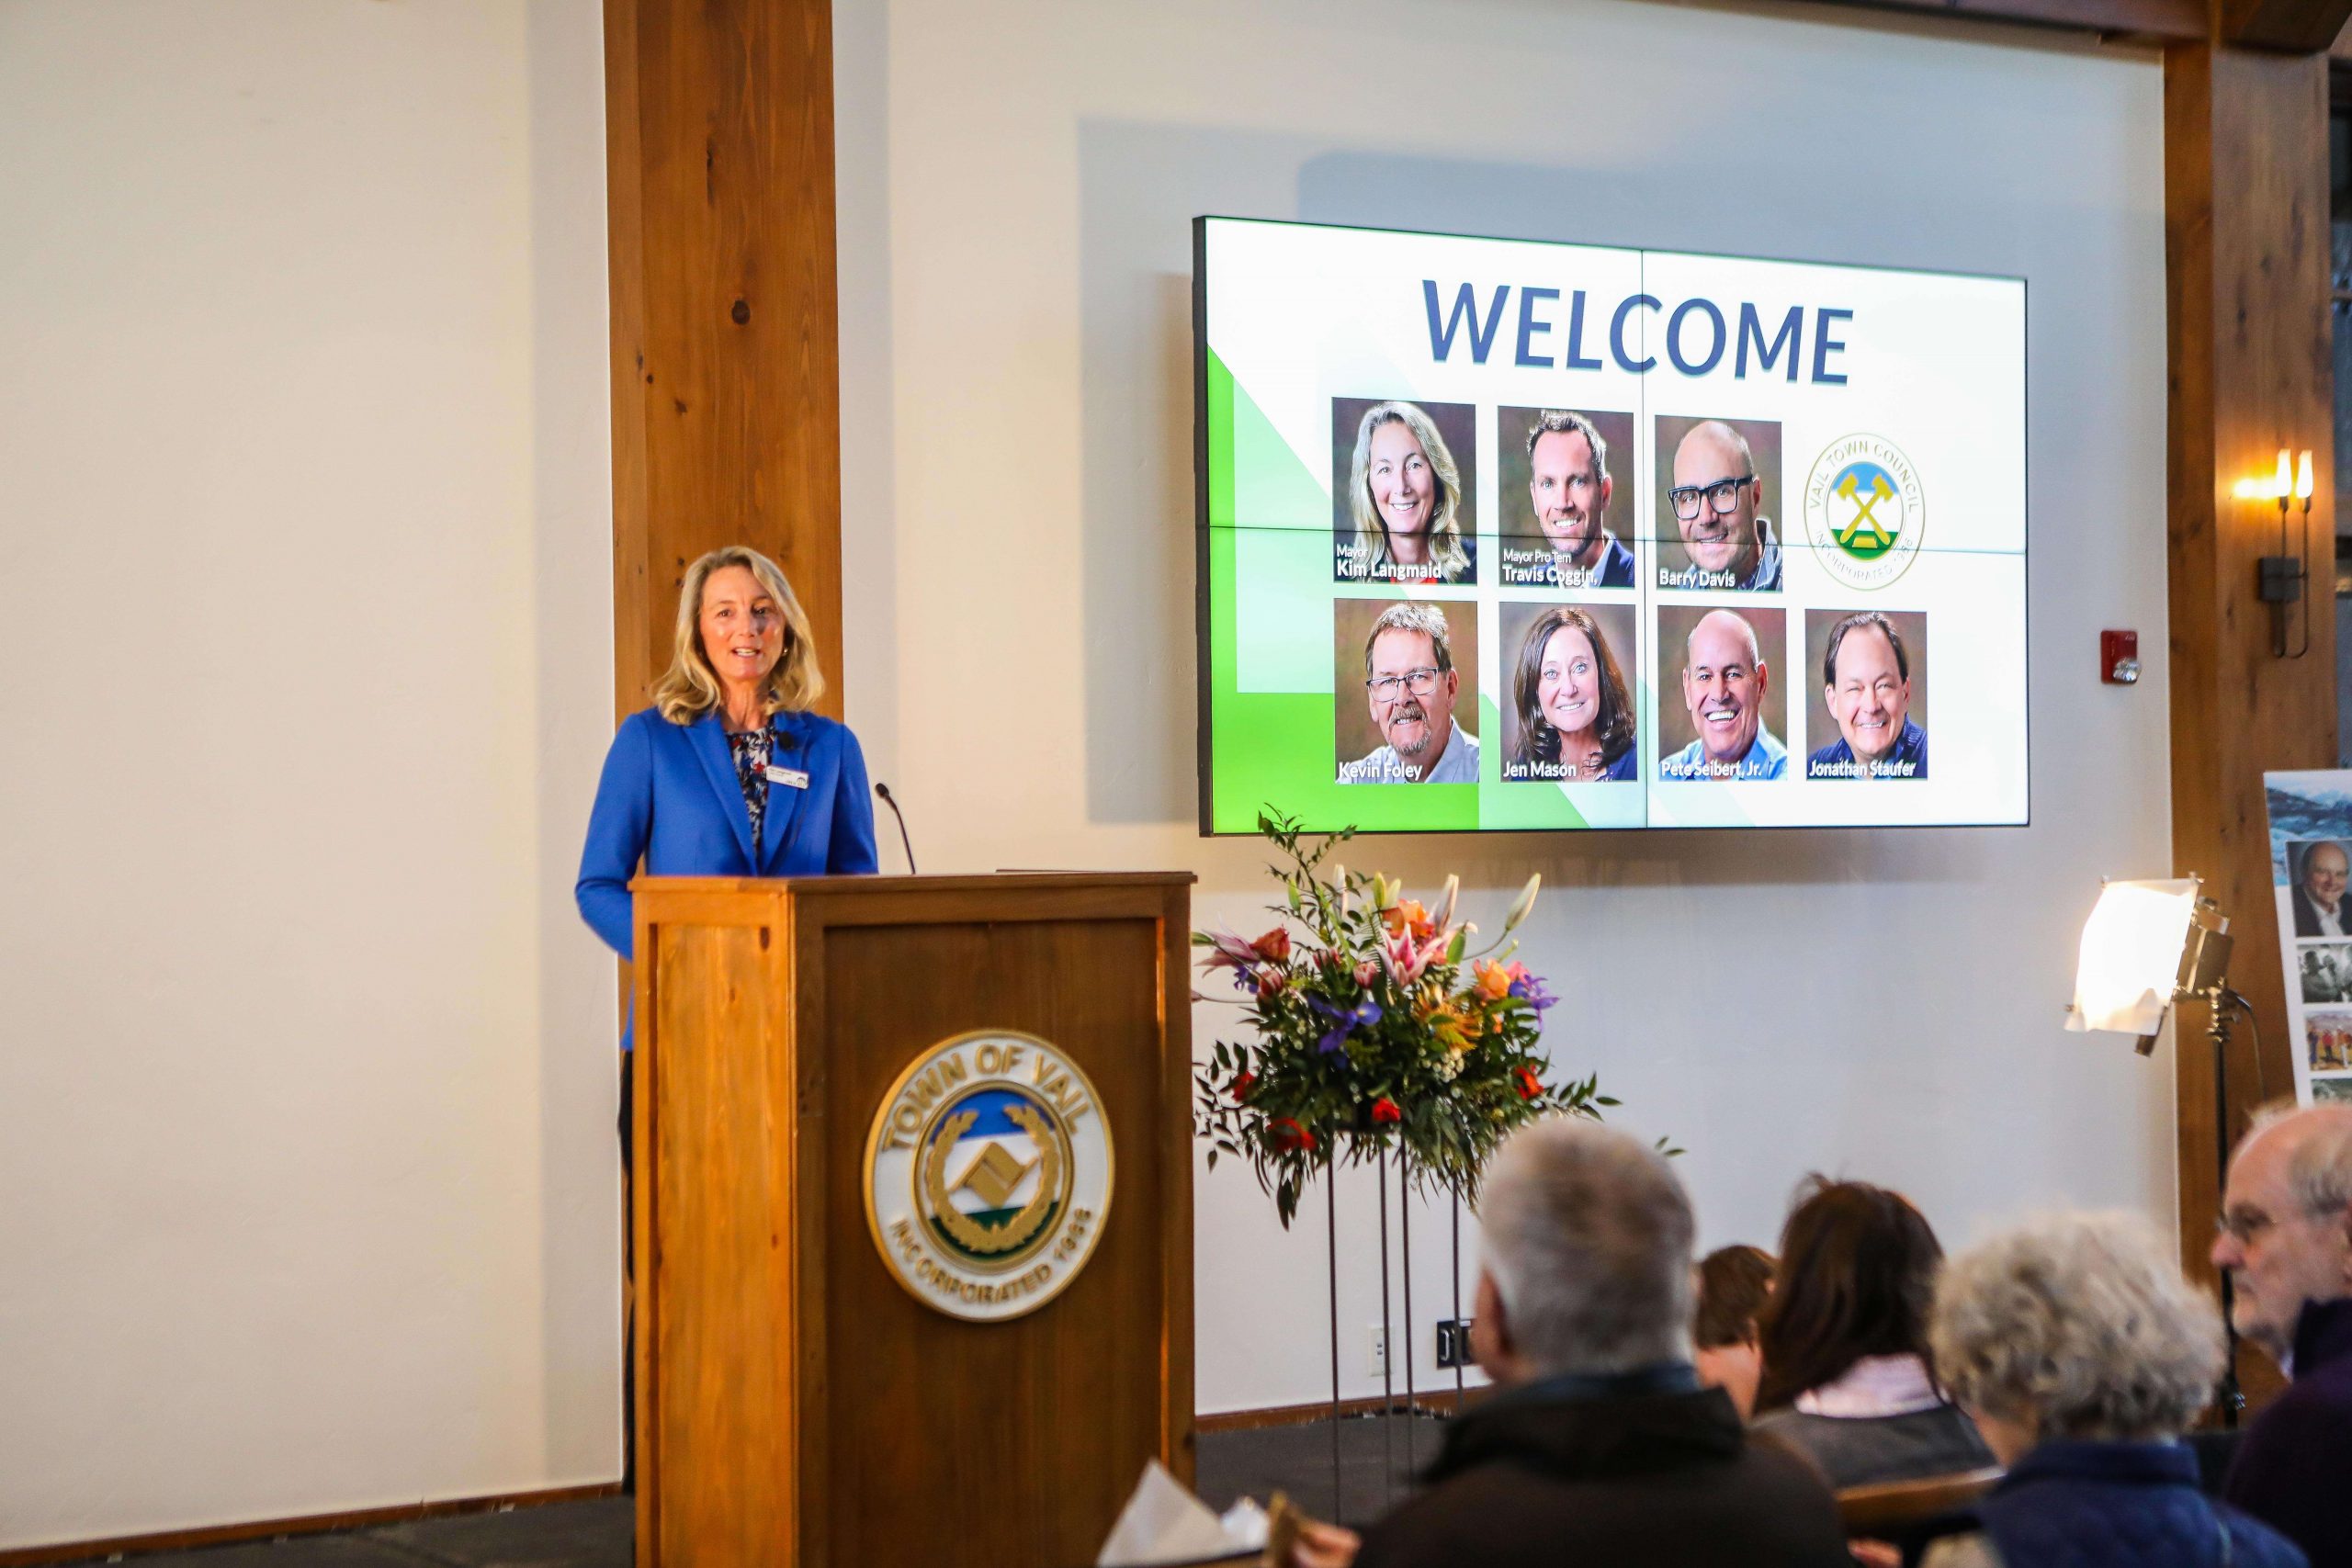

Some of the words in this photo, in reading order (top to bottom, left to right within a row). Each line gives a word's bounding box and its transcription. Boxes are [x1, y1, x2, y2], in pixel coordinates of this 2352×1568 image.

[1422, 279, 1853, 386] WELCOME
[1810, 473, 1829, 509] VAIL
[1826, 440, 1868, 468] TOWN
[1874, 444, 1918, 513] COUNCIL
[1337, 543, 1367, 559] Mayor
[1503, 548, 1533, 564] Mayor
[1534, 550, 1551, 563] Pro
[1554, 551, 1571, 563] Tem
[1337, 559, 1367, 577] Kim
[1371, 561, 1442, 581] Langmaid
[1502, 563, 1544, 582] Travis
[1659, 568, 1697, 589] Barry
[1699, 569, 1736, 587] Davis
[1339, 761, 1379, 778] Kevin
[1384, 761, 1423, 781] Foley
[1503, 760, 1527, 777] Jen
[1530, 761, 1577, 777] Mason
[1661, 761, 1692, 777] Pete
[1693, 760, 1746, 778] Seibert,
[1747, 761, 1762, 777] Jr.
[1809, 759, 1868, 777] Jonathan
[1870, 759, 1917, 777] Staufer
[882, 1052, 967, 1153] TOWN
[975, 1043, 1024, 1074] OF
[1033, 1054, 1091, 1135] VAIL
[889, 1217, 1053, 1304] INCORPORATED
